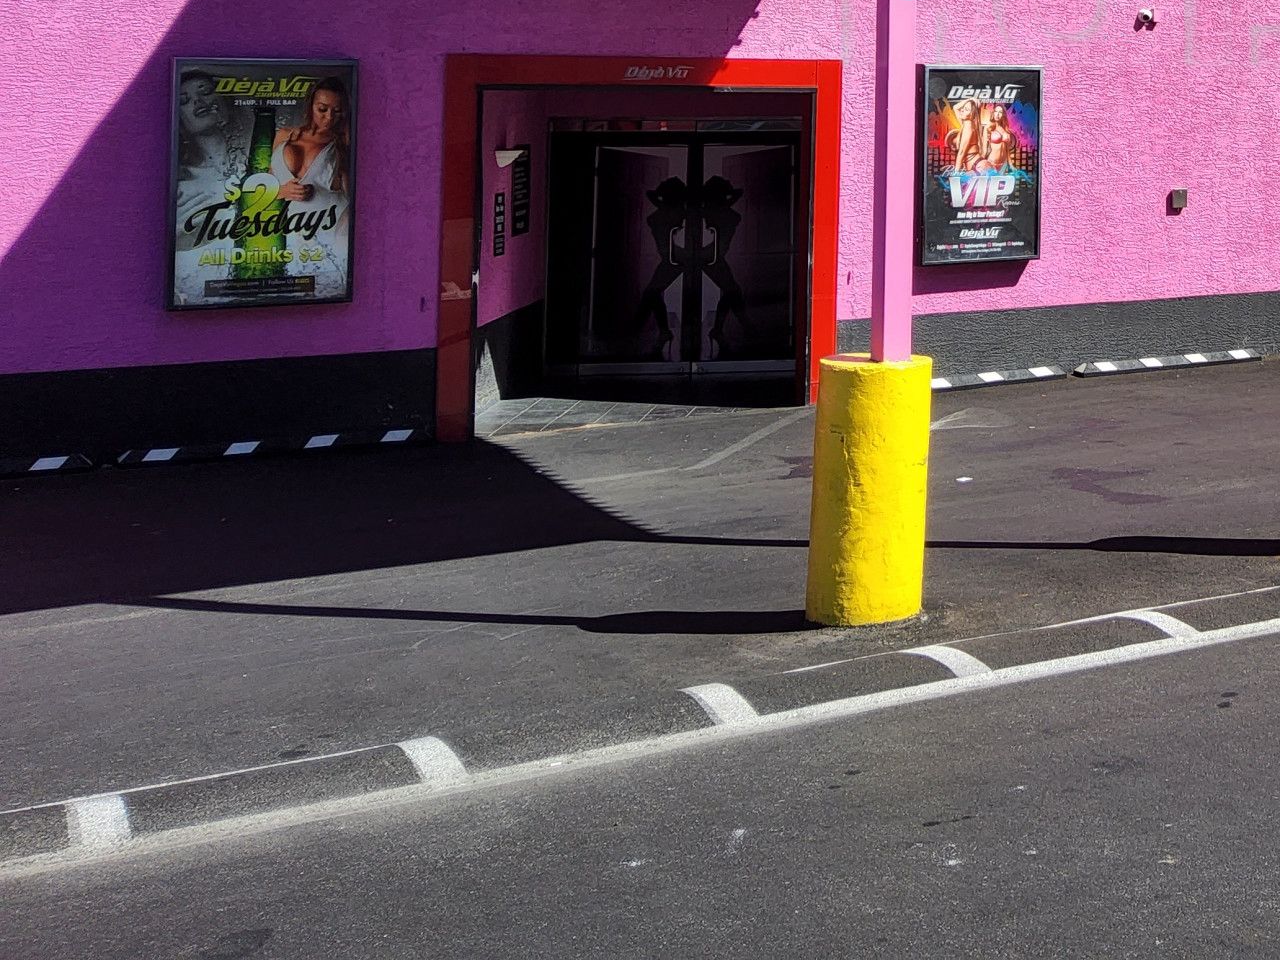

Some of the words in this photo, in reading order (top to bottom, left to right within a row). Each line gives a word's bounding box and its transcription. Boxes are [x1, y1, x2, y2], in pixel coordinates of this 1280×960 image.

[278, 75, 321, 93] Vu
[994, 84, 1026, 99] Vu
[223, 172, 280, 222] $2
[949, 175, 1015, 208] VIP
[184, 200, 338, 248] Tuesdays
[198, 249, 226, 266] All
[231, 246, 294, 266] Drinks
[298, 246, 324, 263] $2
